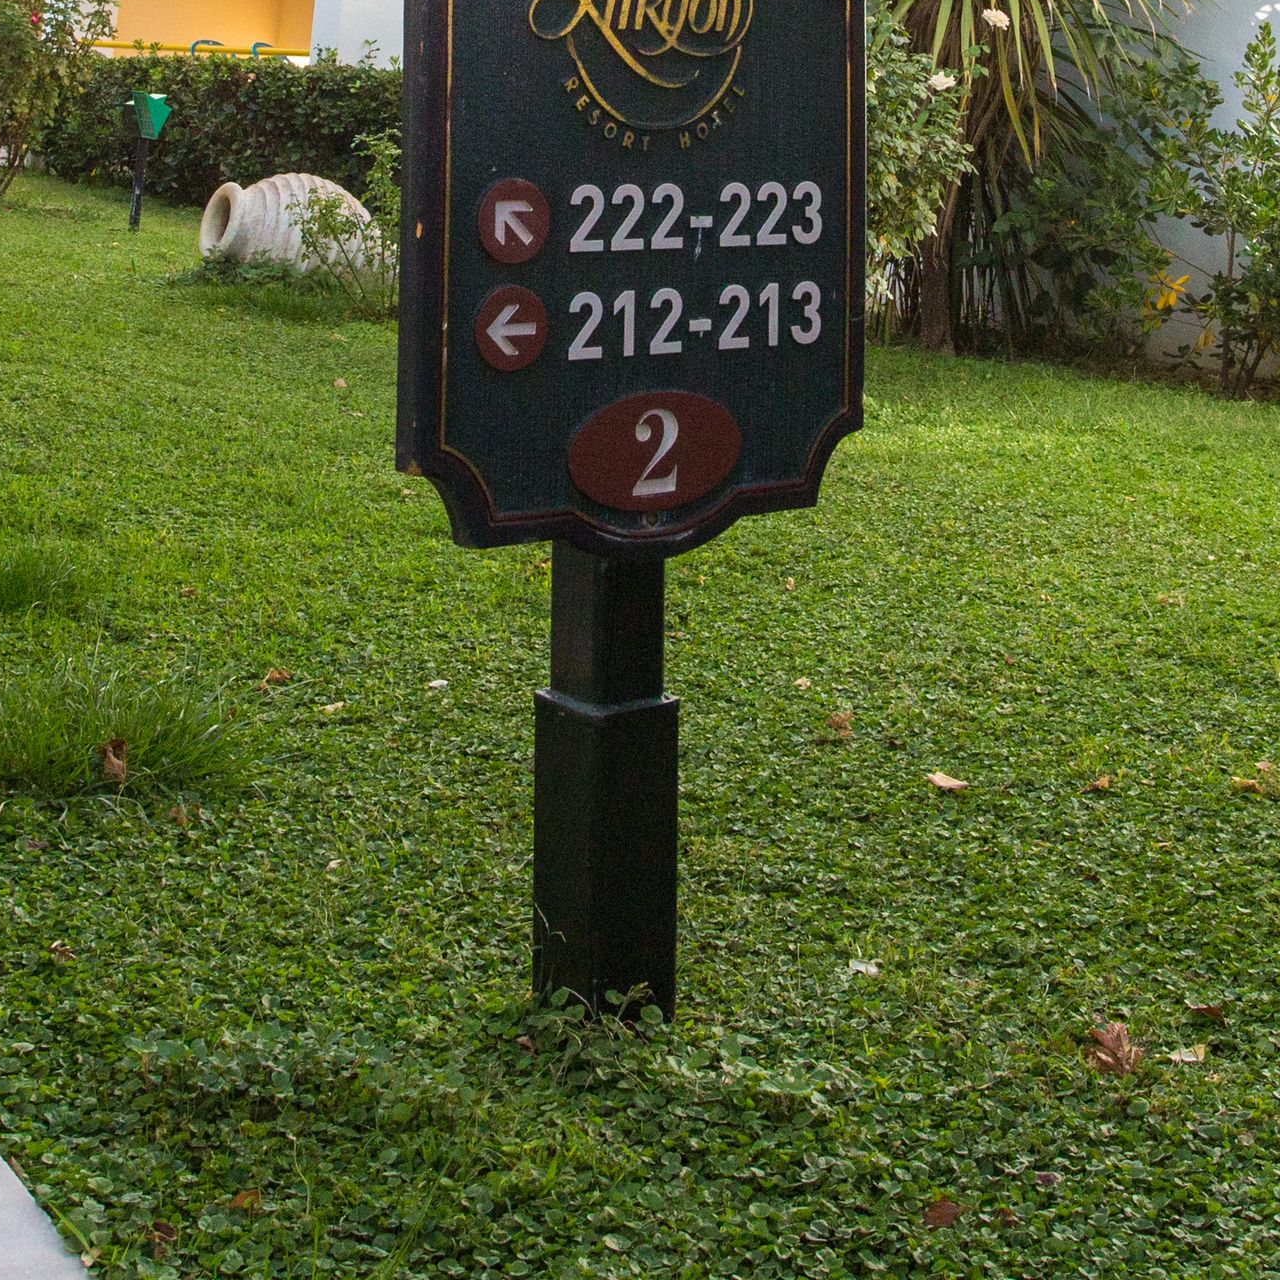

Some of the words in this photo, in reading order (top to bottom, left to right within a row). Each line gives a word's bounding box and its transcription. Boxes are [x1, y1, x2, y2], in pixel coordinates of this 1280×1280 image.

[564, 76, 650, 151] RESORT
[679, 85, 745, 149] HOTEL
[569, 181, 822, 253] 222-223
[567, 280, 822, 360] 212-213
[632, 408, 679, 496] 2
